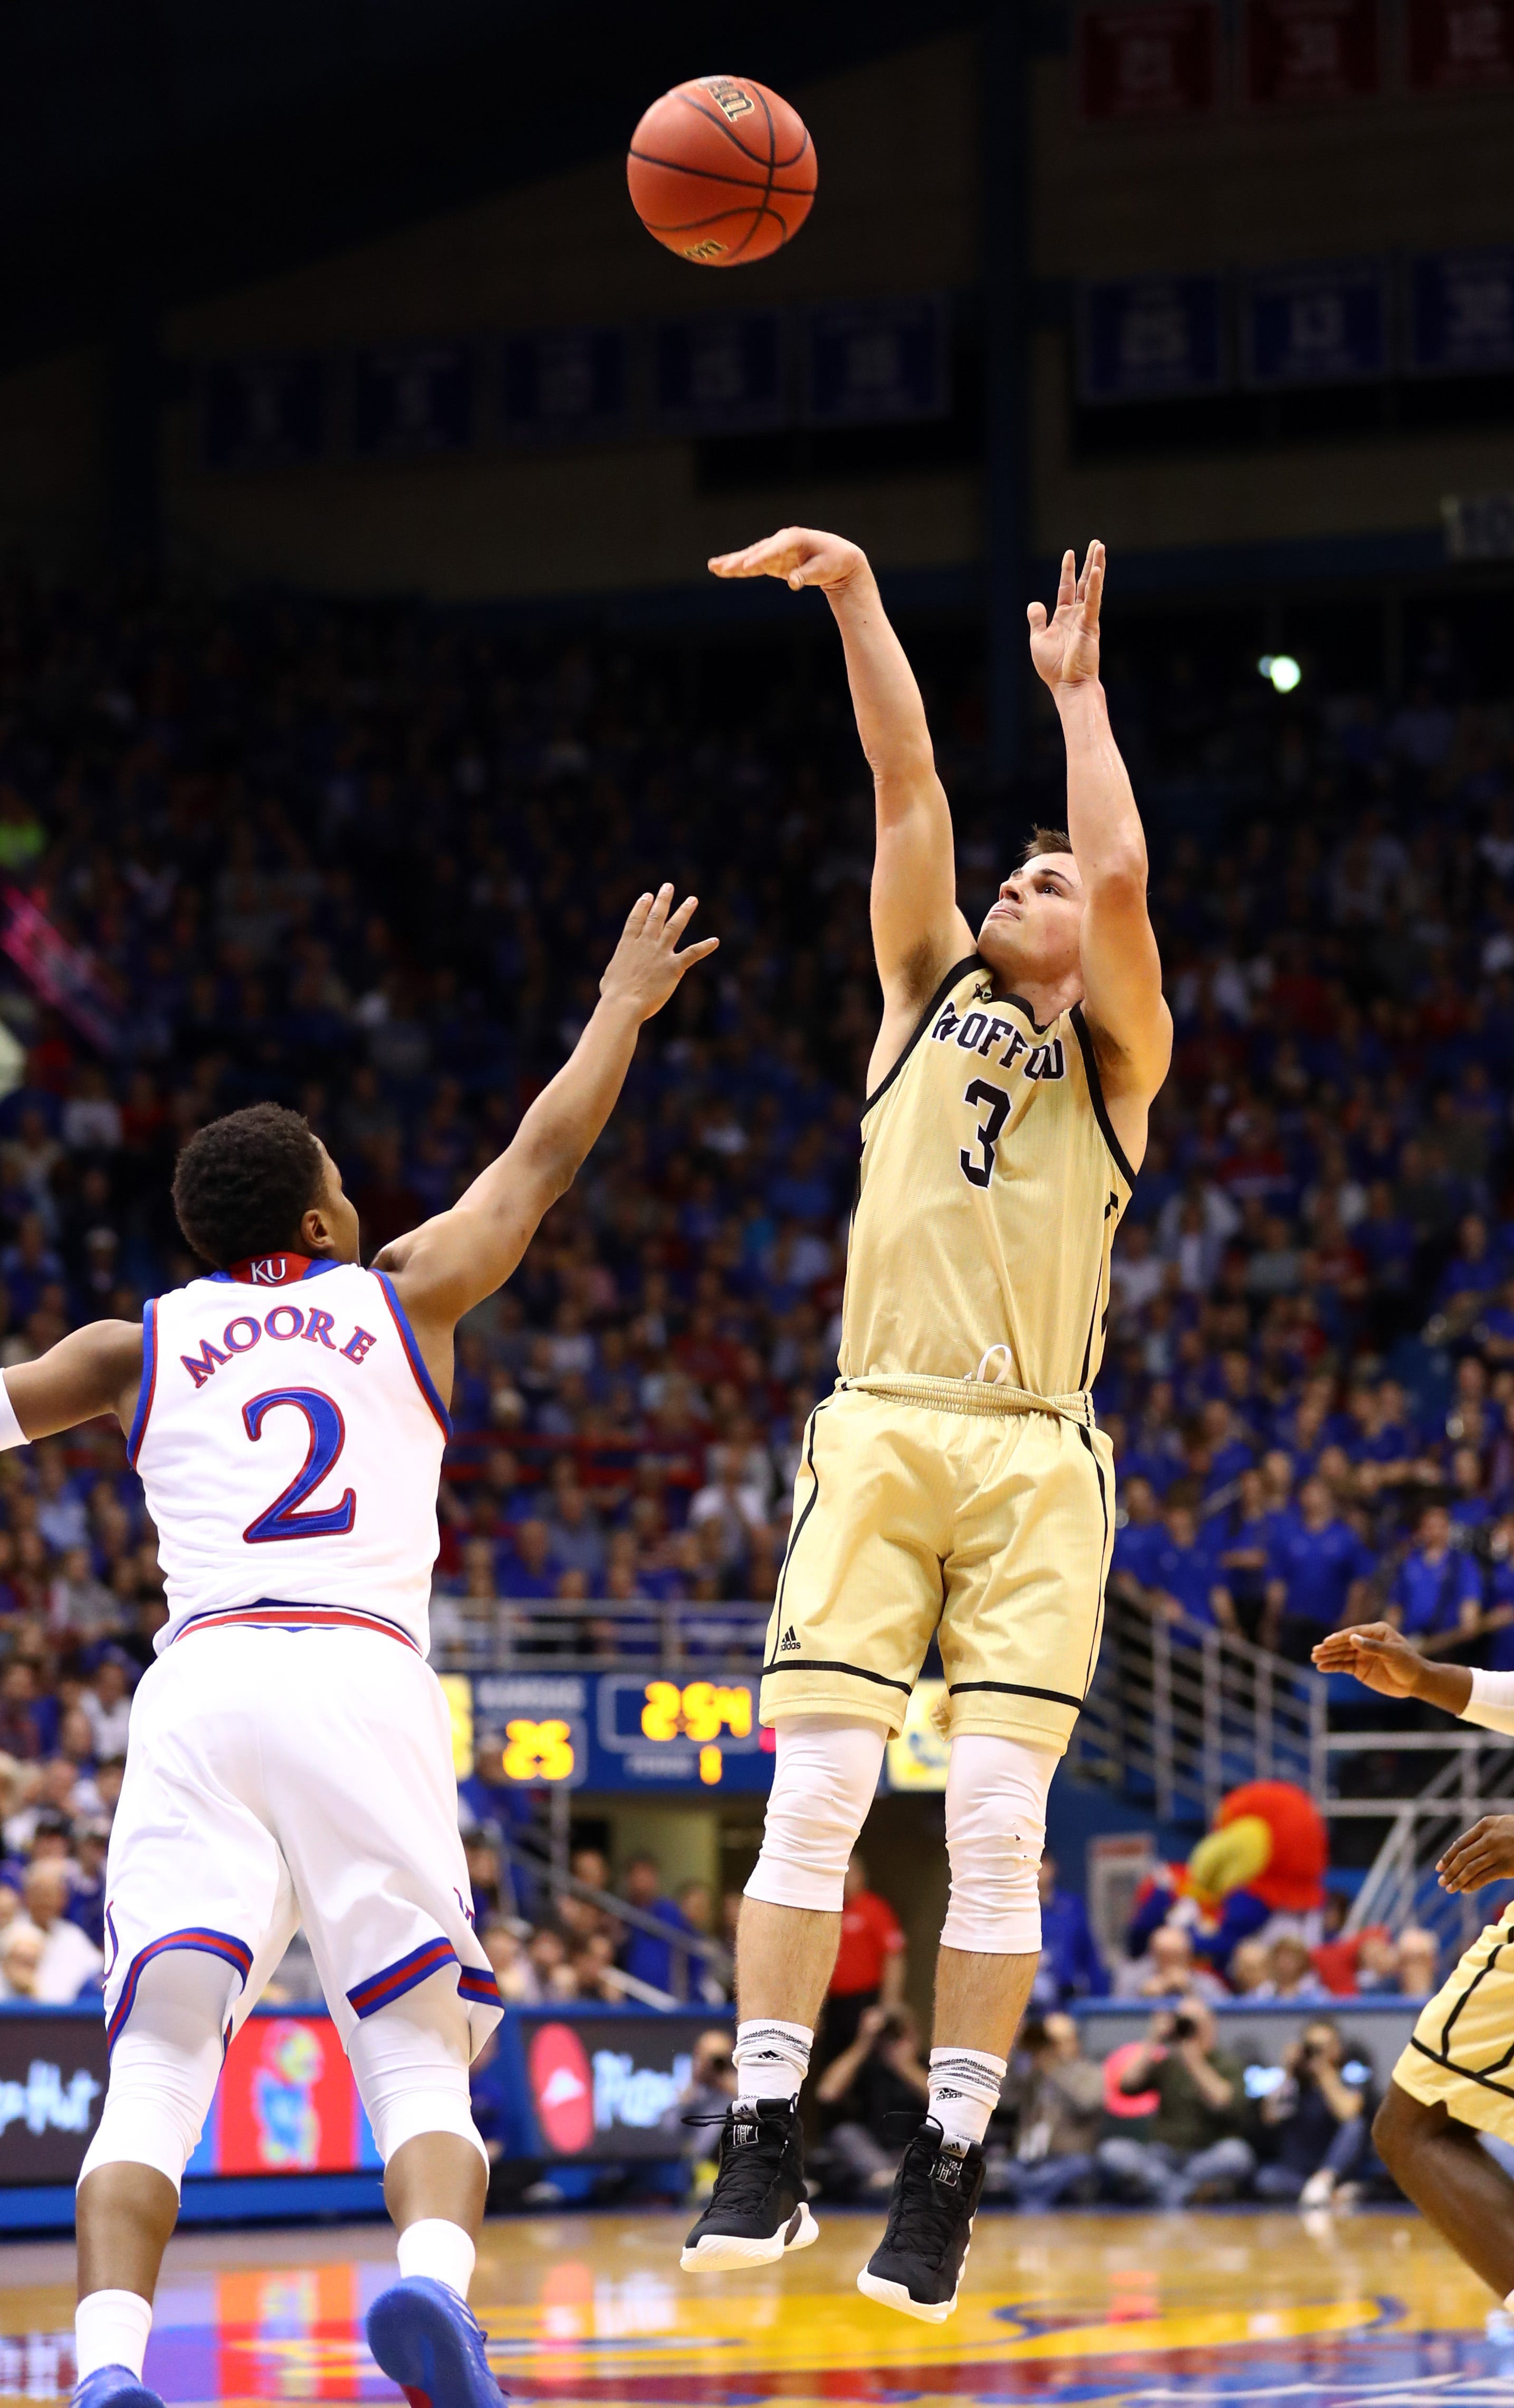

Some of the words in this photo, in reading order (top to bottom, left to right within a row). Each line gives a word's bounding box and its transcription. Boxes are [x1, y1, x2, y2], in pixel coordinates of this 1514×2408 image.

[960, 1078, 1011, 1189] 3
[250, 1258, 286, 1283] KU
[180, 1306, 377, 1388] MOORE
[242, 1386, 357, 1544] 2
[503, 1720, 574, 1780] 25
[936, 2092, 962, 2102] adidas
